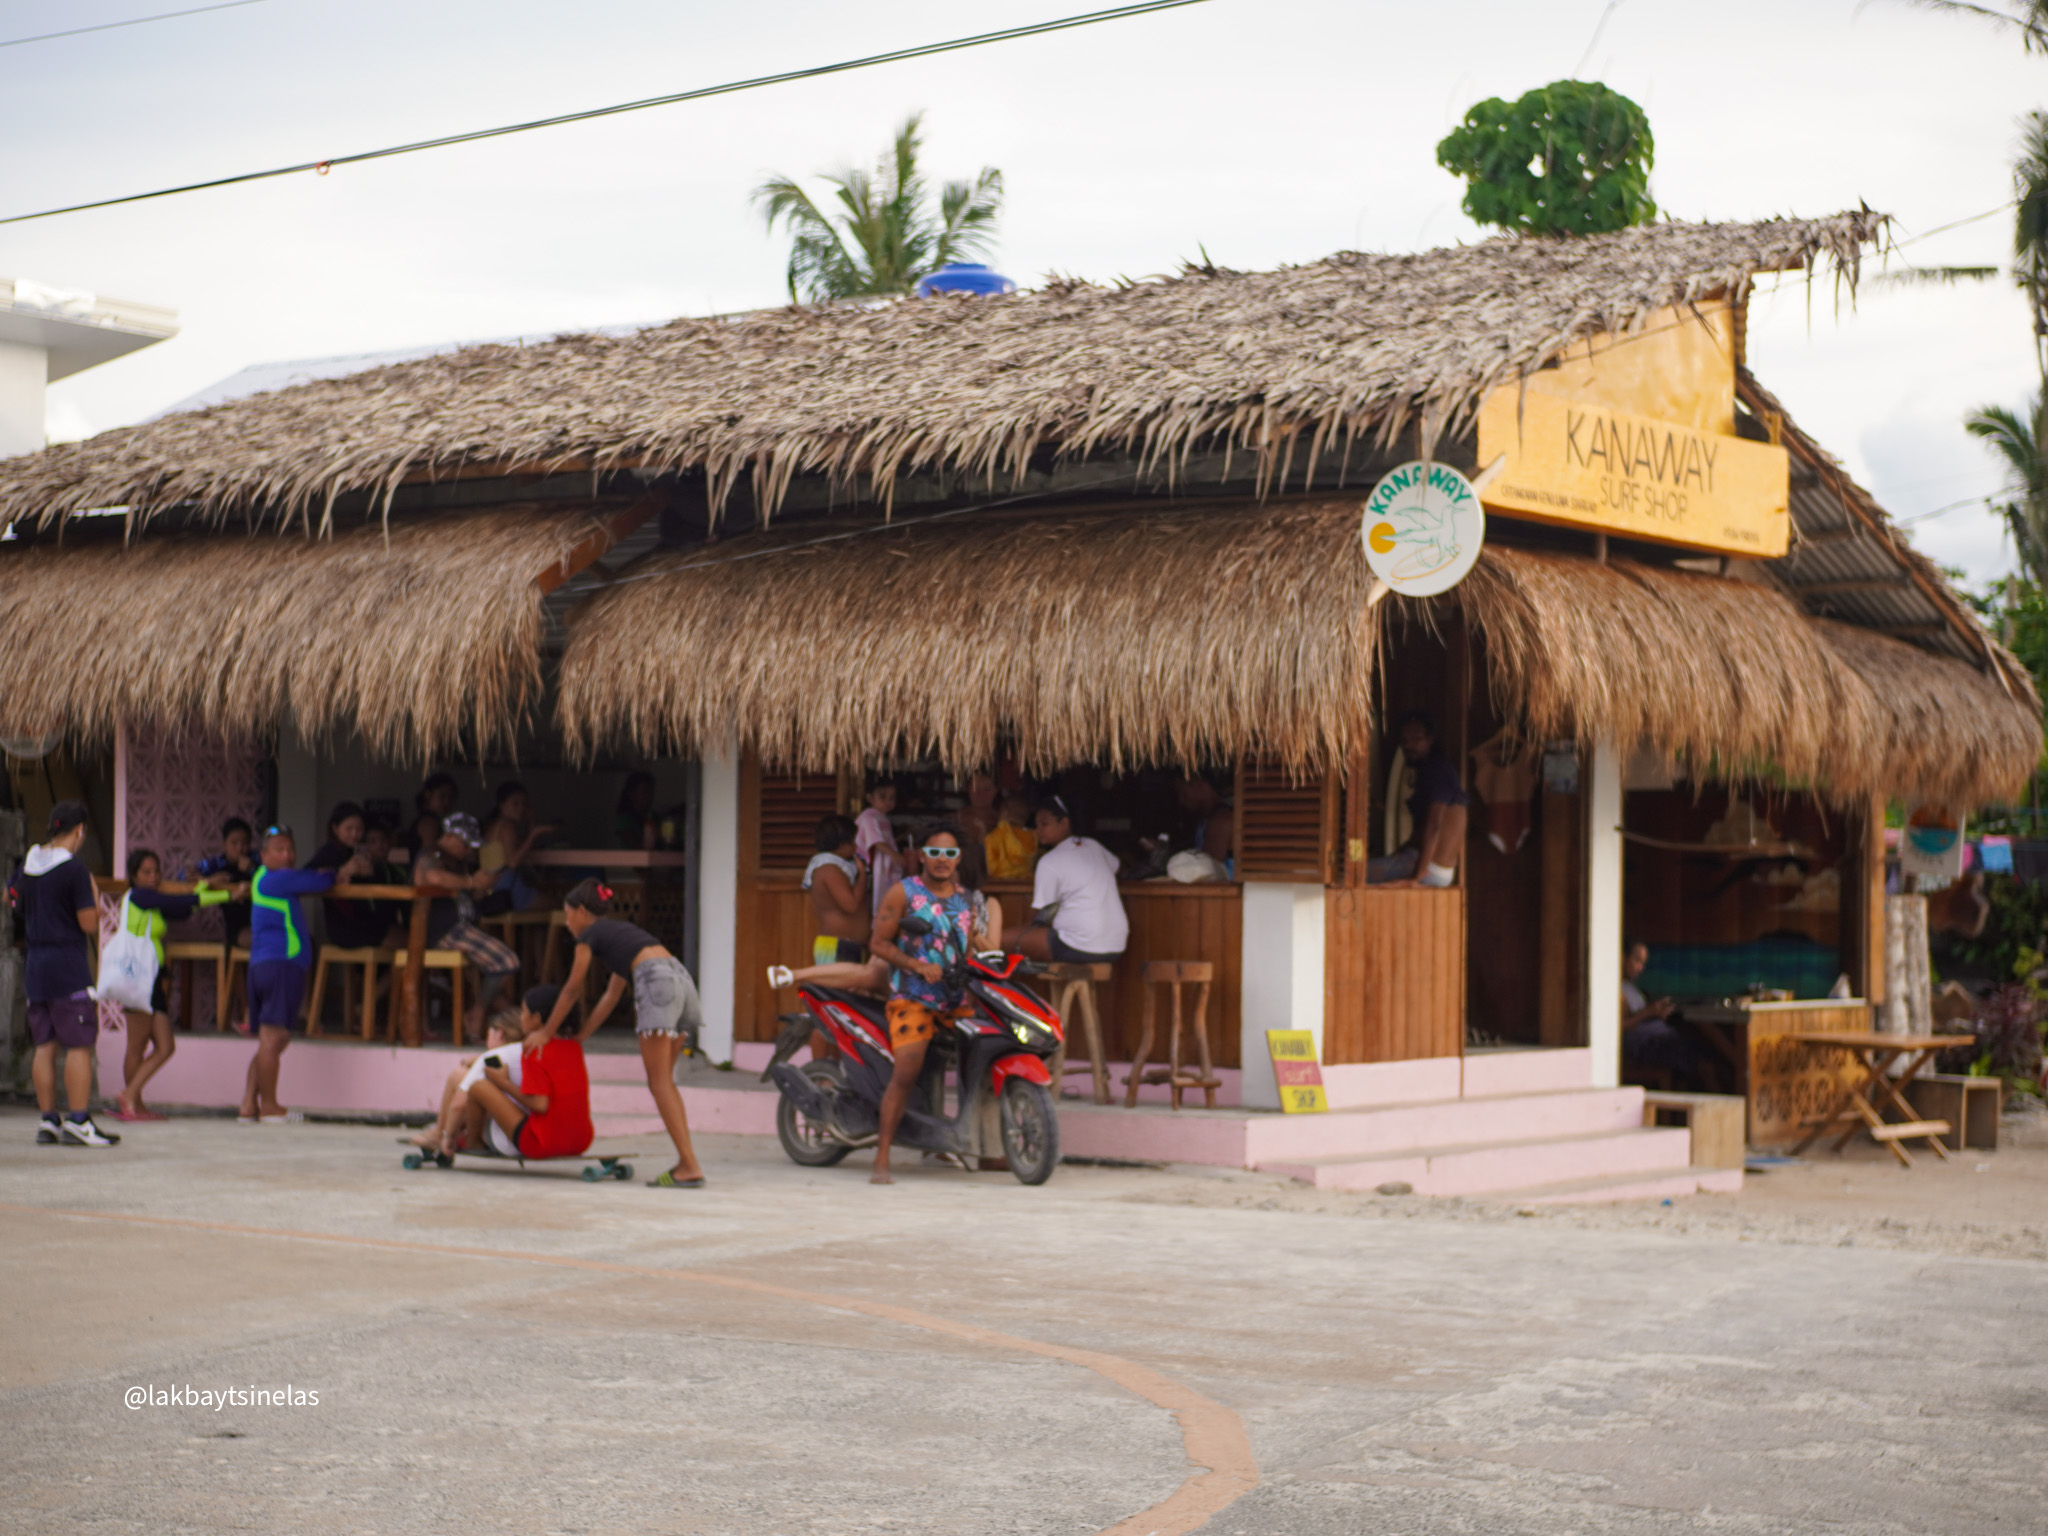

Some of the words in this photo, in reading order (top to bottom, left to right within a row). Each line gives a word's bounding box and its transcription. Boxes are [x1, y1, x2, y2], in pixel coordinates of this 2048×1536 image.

[1565, 408, 1718, 494] KANAWAY
[1369, 465, 1472, 516] KANAWAY
[1600, 477, 1640, 513] SURF
[1644, 486, 1688, 523] SHOP
